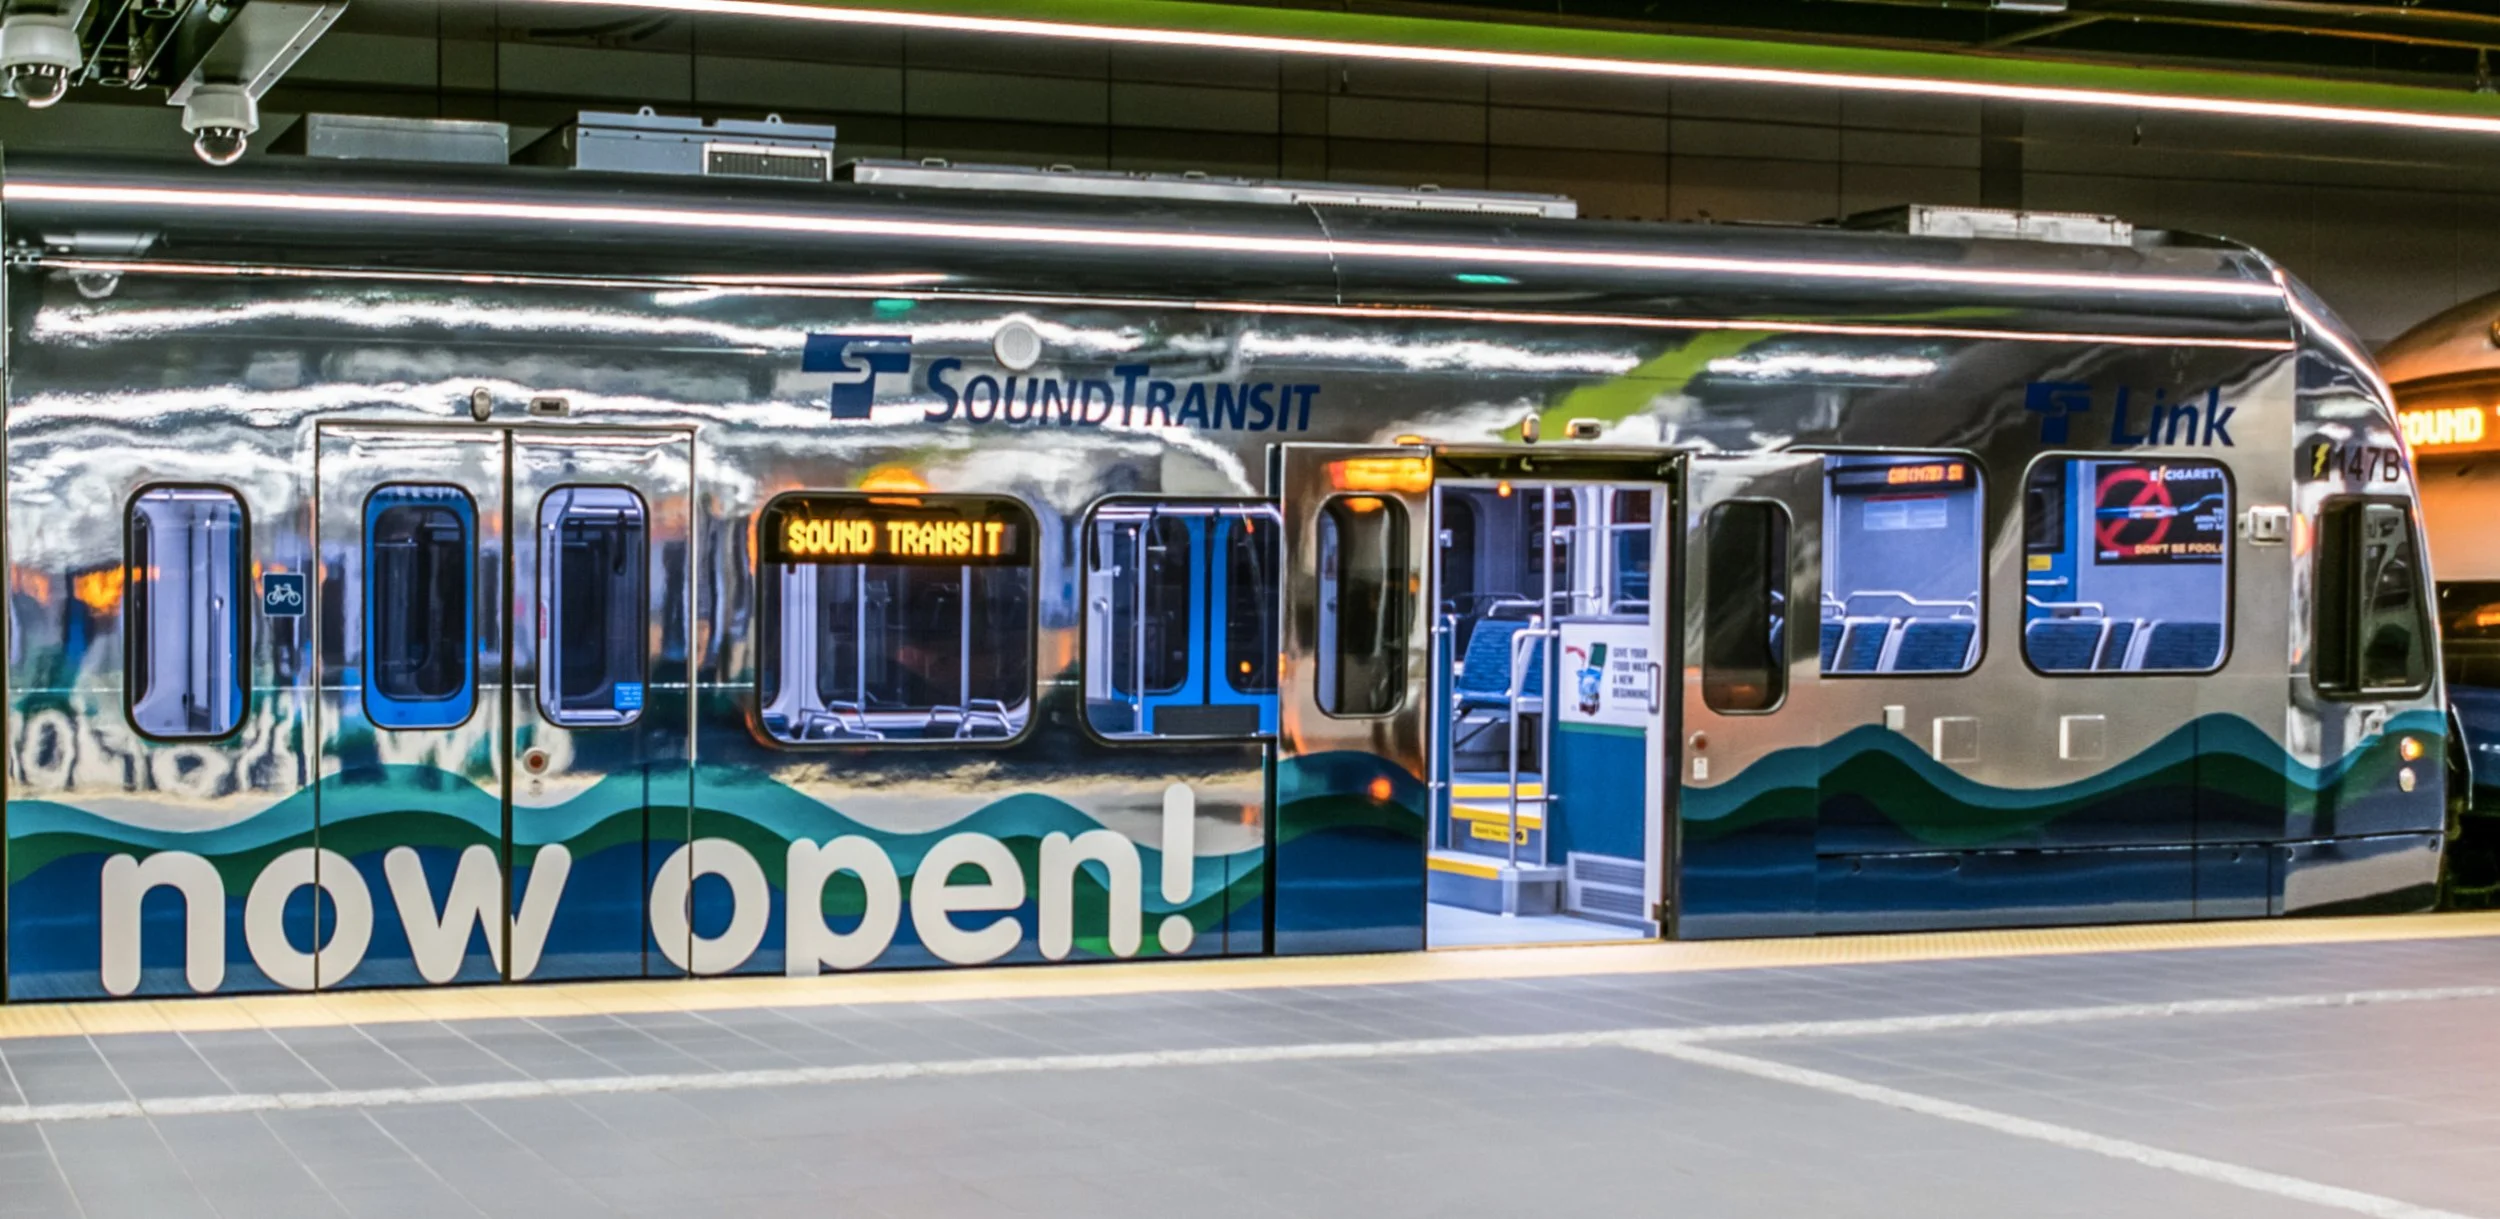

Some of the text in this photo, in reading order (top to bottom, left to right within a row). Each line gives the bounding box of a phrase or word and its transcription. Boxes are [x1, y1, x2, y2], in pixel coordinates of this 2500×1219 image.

[2110, 385, 2237, 447] Link
[2336, 445, 2400, 483] 147B
[788, 519, 1004, 556] SOUND TRANSIT
[2171, 543, 2186, 554] BE
[101, 782, 1196, 996] now open!
